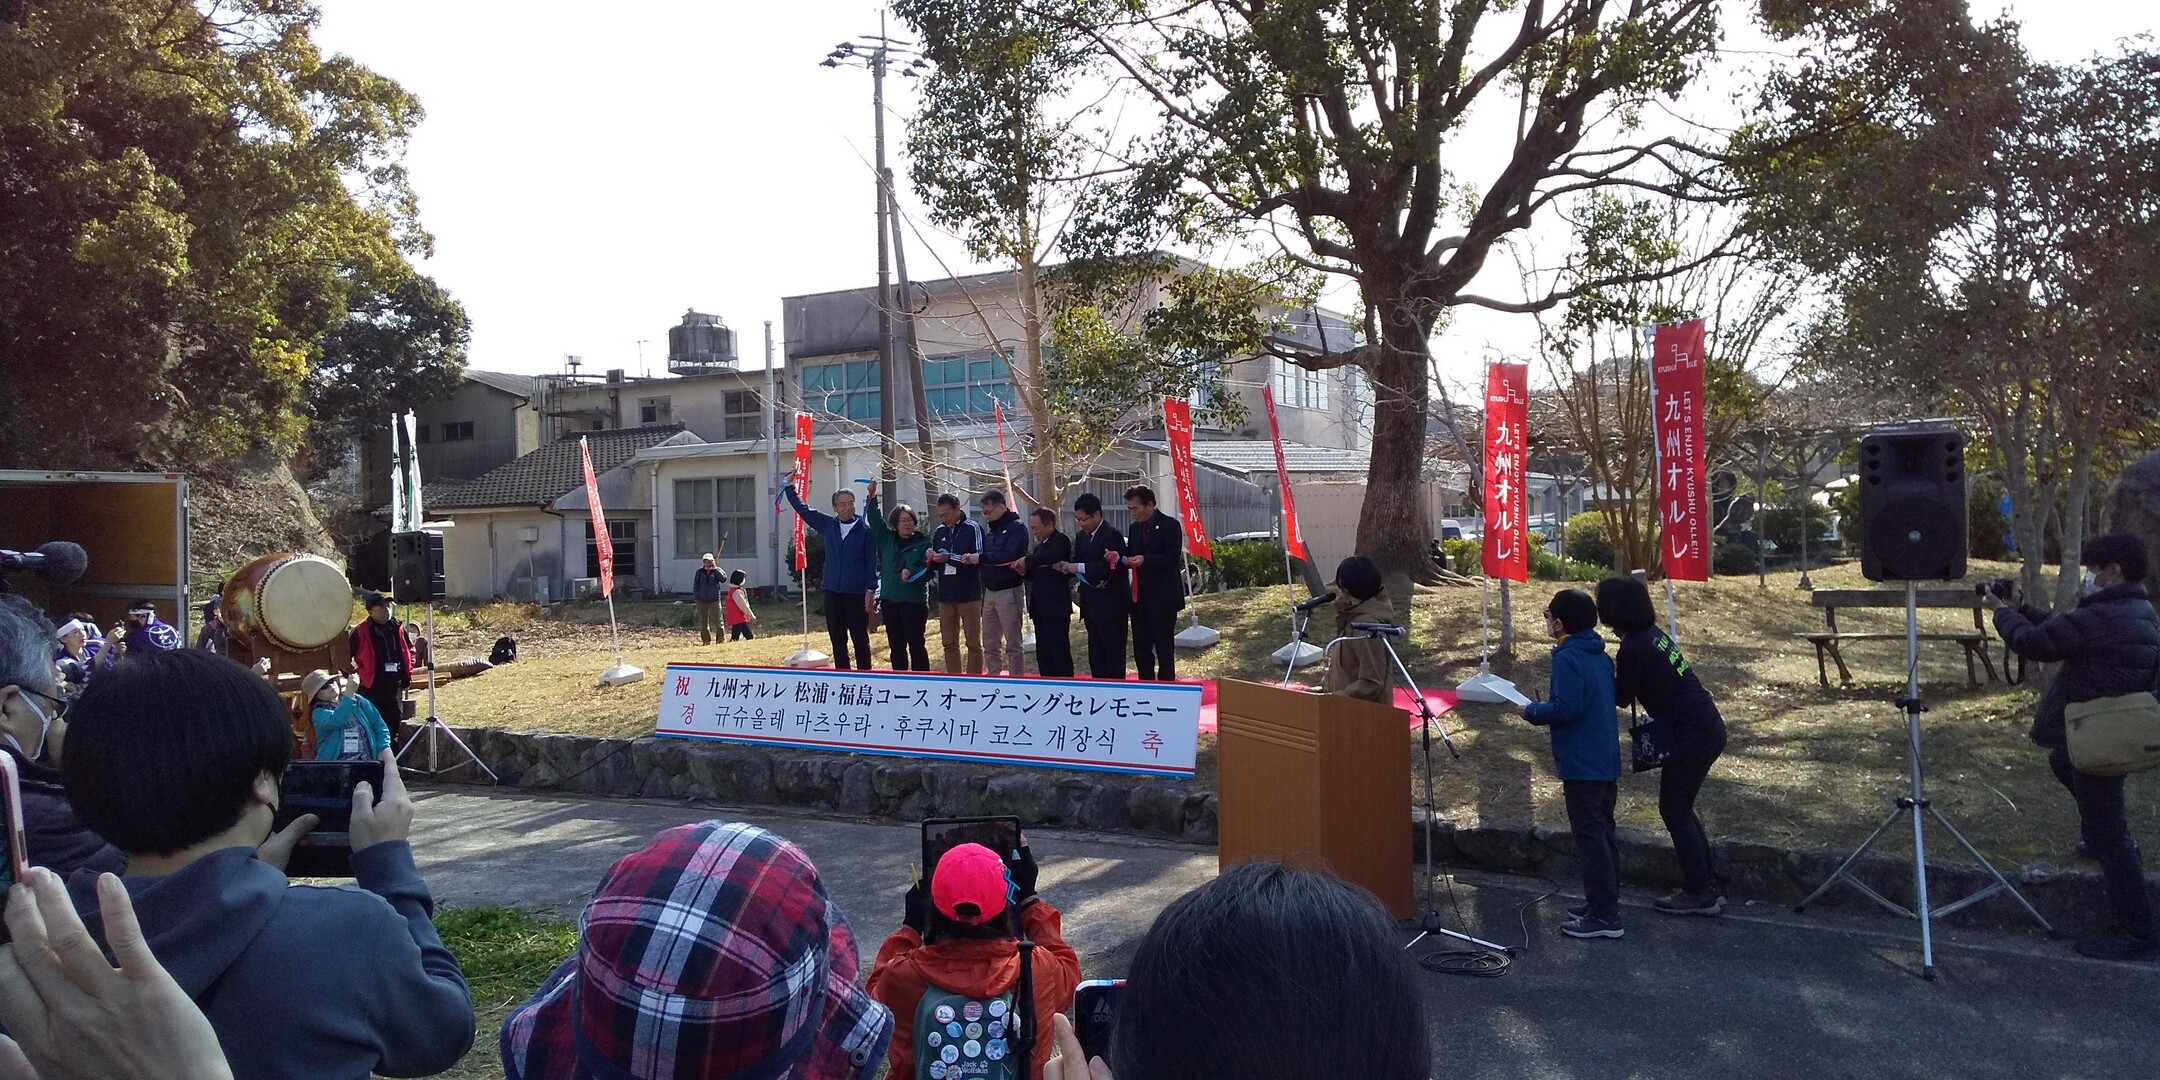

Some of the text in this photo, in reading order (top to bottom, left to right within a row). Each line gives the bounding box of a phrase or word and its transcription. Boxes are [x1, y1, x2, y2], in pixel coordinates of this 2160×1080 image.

[1493, 421, 1512, 559] 九州オルレ
[1664, 394, 1687, 559] 九州オルレ
[1683, 391, 1699, 559] LET'S ENJOY KYUSHU OLLE!!!
[674, 675, 1178, 719] 祝 九州オルレ 松浦・福島コース オープニングセレモニー
[681, 703, 695, 725] 경
[715, 705, 785, 732] 규슈올레
[795, 709, 871, 739] 마츠우라
[893, 714, 979, 746] 후쿠시마
[989, 724, 1034, 747] 코스
[1046, 724, 1116, 755] 개장식
[1142, 729, 1164, 759] 축
[961, 1060, 977, 1068] Jack
[961, 1066, 989, 1074] Wolfskin
